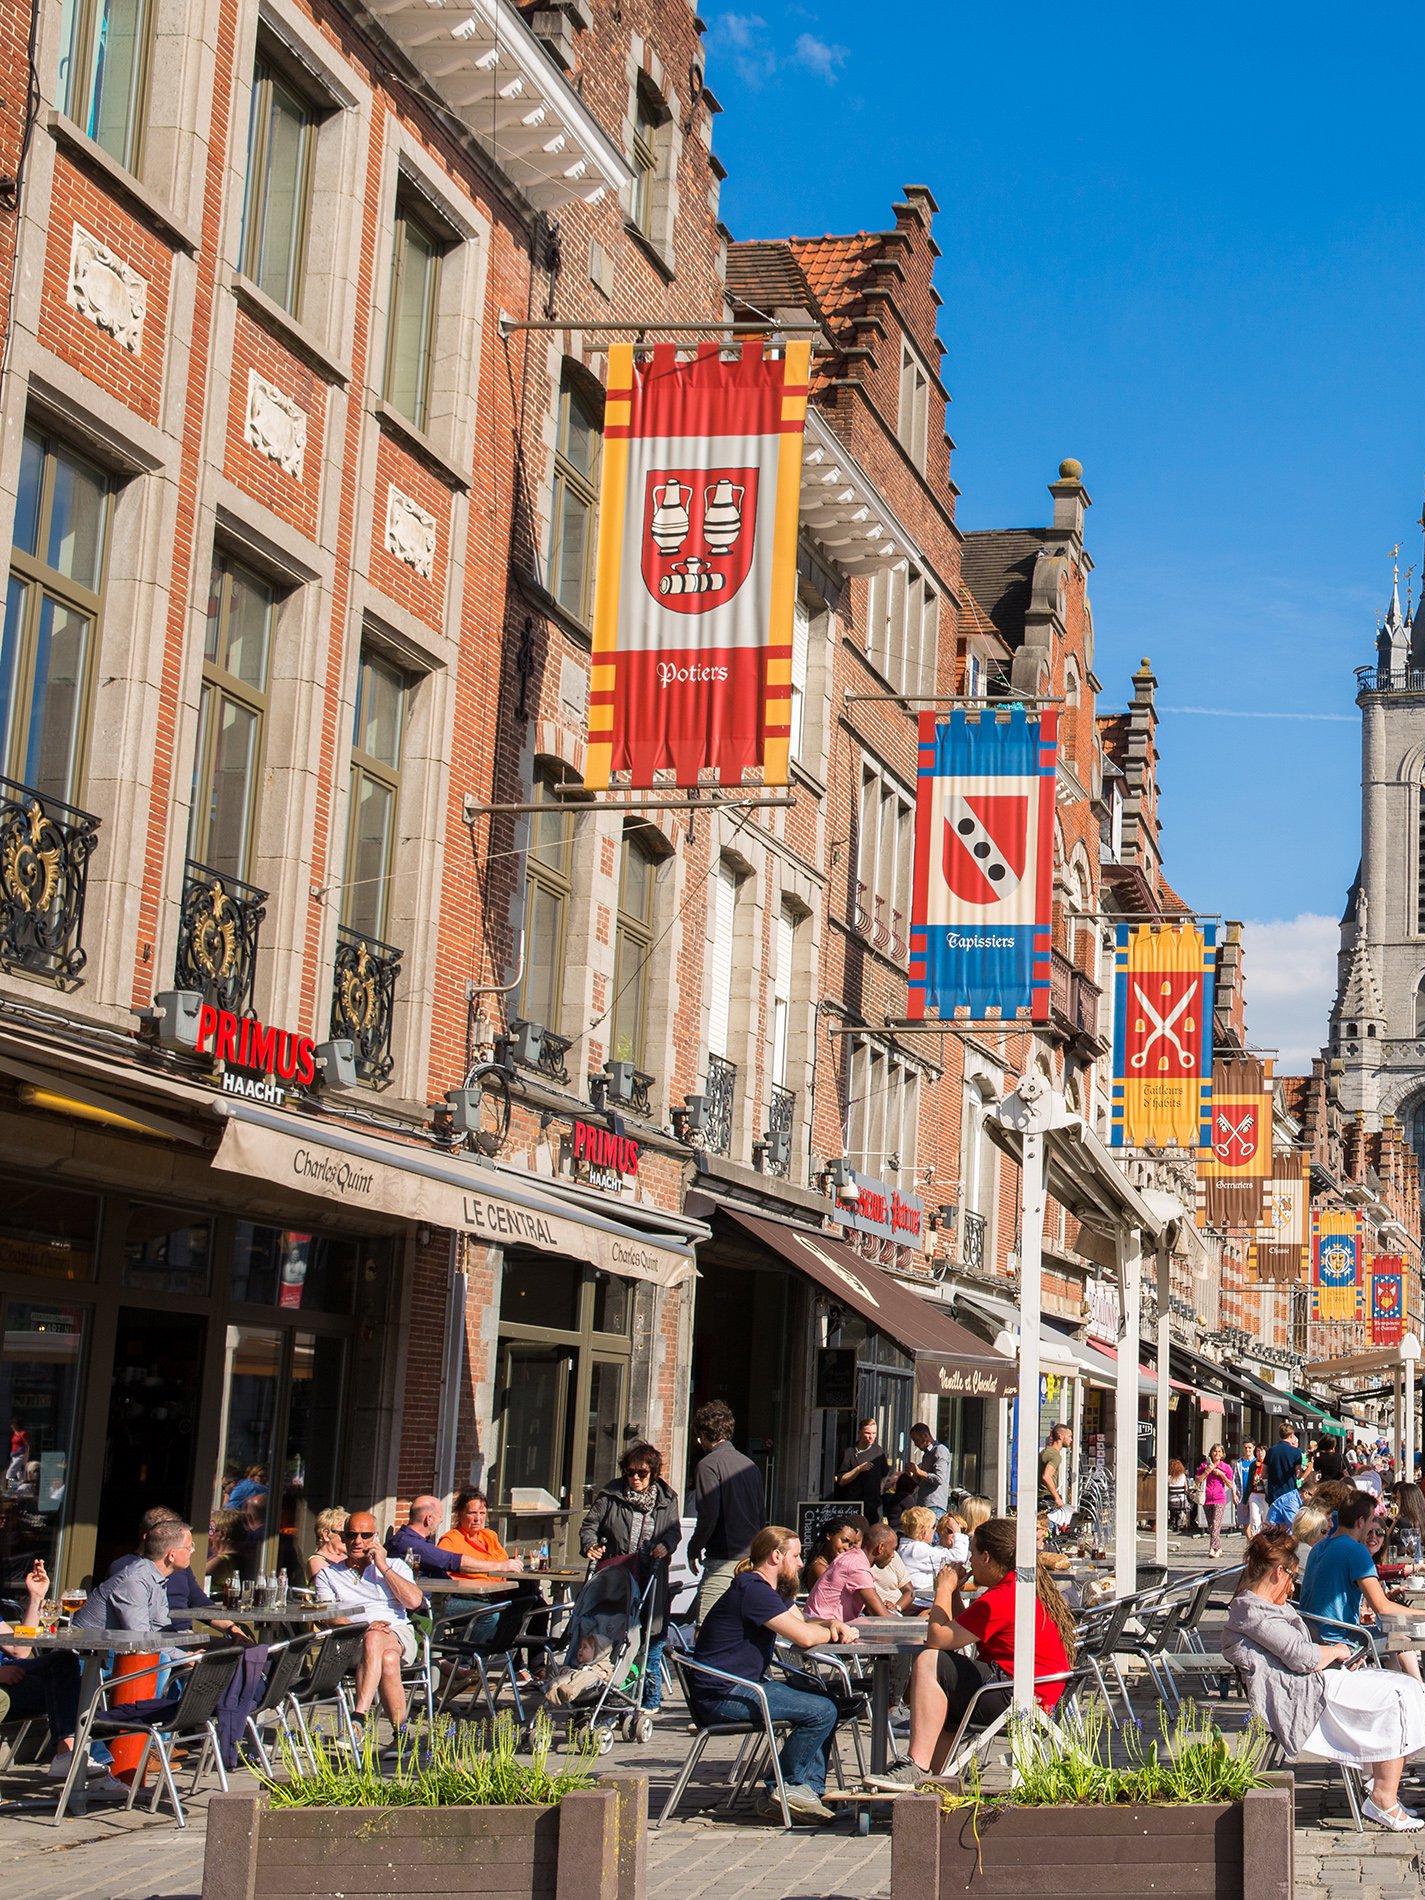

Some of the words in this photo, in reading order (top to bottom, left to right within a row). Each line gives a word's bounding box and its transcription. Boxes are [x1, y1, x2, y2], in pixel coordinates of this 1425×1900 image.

[657, 662, 728, 689] Potiers
[946, 932, 1015, 952] Tapissiers
[195, 1004, 315, 1085] PRIMUS
[222, 1072, 285, 1105] HAACHT
[1143, 1084, 1183, 1095] Tailleurs
[574, 1121, 639, 1176] PRIMUS
[293, 1149, 337, 1183] Charles
[337, 1163, 374, 1194] Quint
[589, 1170, 623, 1192] HAACHT
[463, 1197, 485, 1227] LE
[487, 1203, 558, 1246] CENTRAL
[612, 1242, 640, 1267] Charles
[641, 1250, 659, 1274] Quint
[938, 1366, 964, 1391] Vanille
[964, 1374, 972, 1391] et
[972, 1369, 998, 1395] Chocolat
